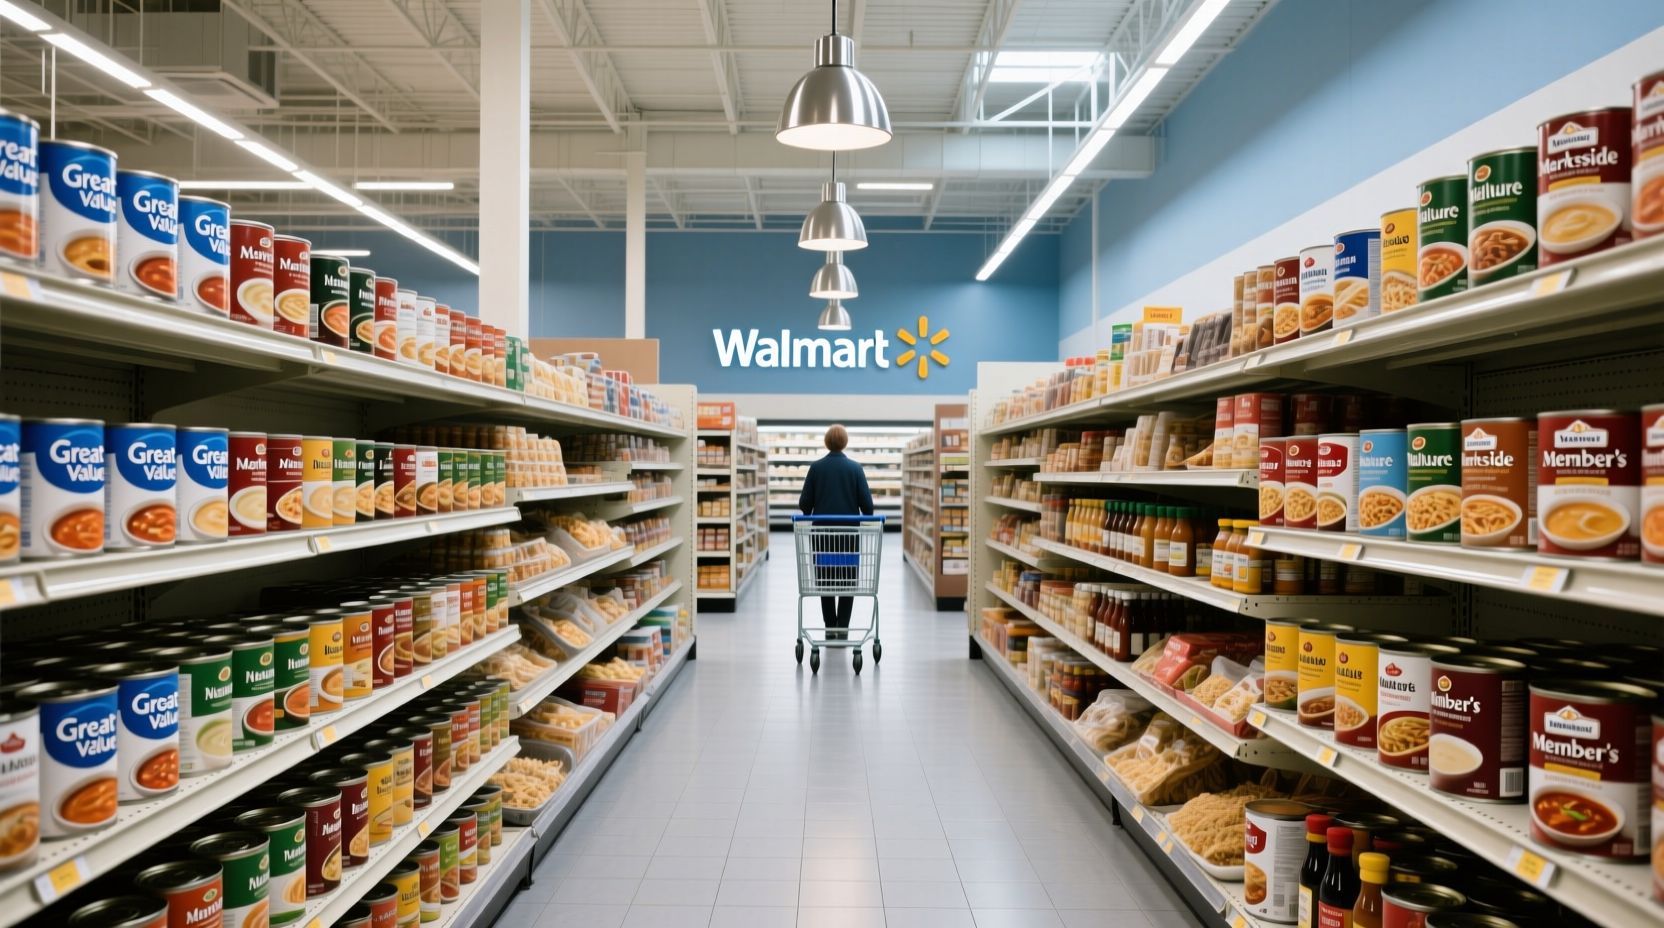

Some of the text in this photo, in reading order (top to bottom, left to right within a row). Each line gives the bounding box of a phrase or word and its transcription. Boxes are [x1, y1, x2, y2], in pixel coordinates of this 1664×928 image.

[62, 163, 117, 198] Great
[712, 329, 890, 368] Walmart
[50, 438, 104, 464] Great
[127, 441, 176, 465] Great
[1542, 448, 1627, 468] Member's
[132, 691, 179, 715] Great
[56, 713, 116, 742] Great
[1533, 731, 1619, 764] Member's
